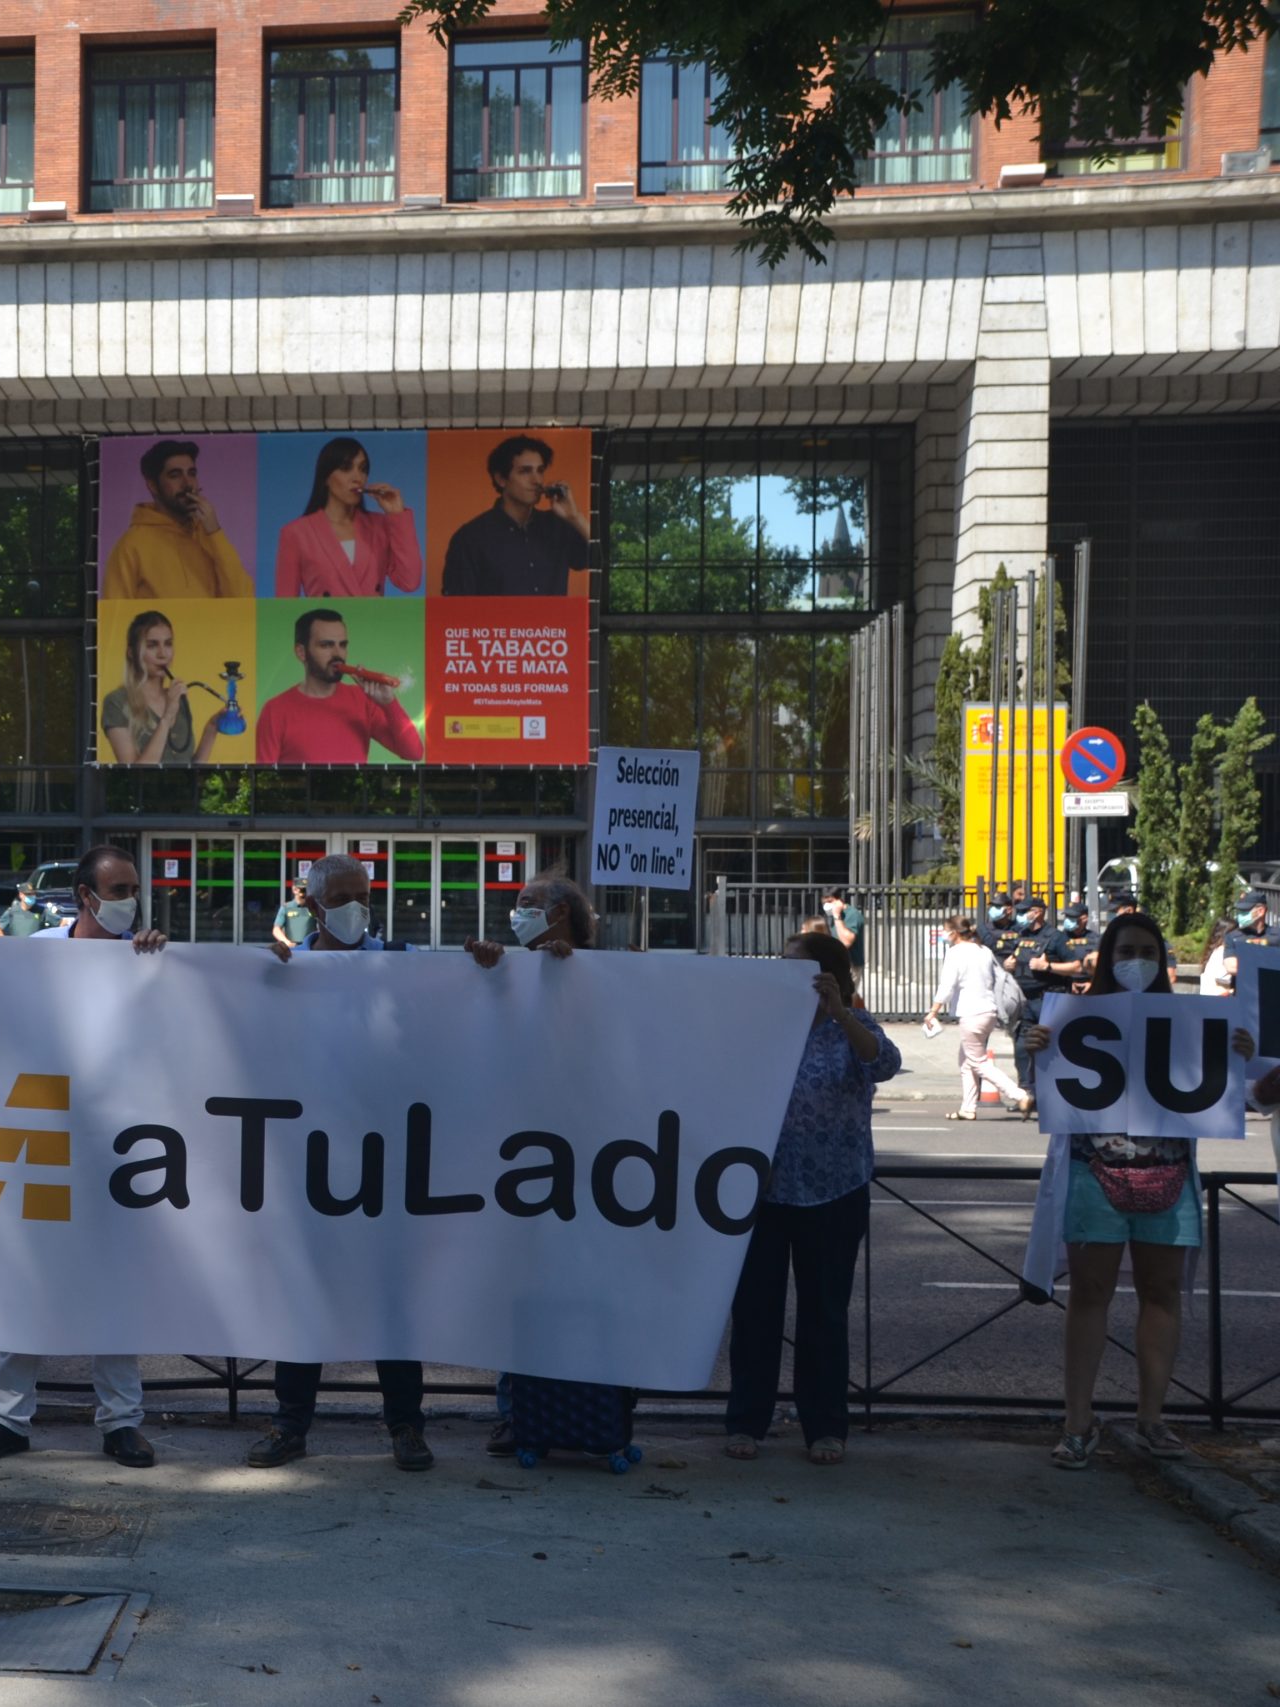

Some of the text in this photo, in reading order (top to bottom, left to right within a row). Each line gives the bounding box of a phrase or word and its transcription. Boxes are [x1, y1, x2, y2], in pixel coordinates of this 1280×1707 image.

[445, 626, 566, 638] QUE NO TE ENGAÑEN
[446, 640, 568, 657] EL TABACO
[445, 660, 568, 674] ATA Y TE MATA
[445, 683, 569, 693] EN TODAS SUS FORMAS
[616, 756, 679, 786] Selección
[608, 803, 679, 836] presencial,
[596, 843, 620, 871] NO
